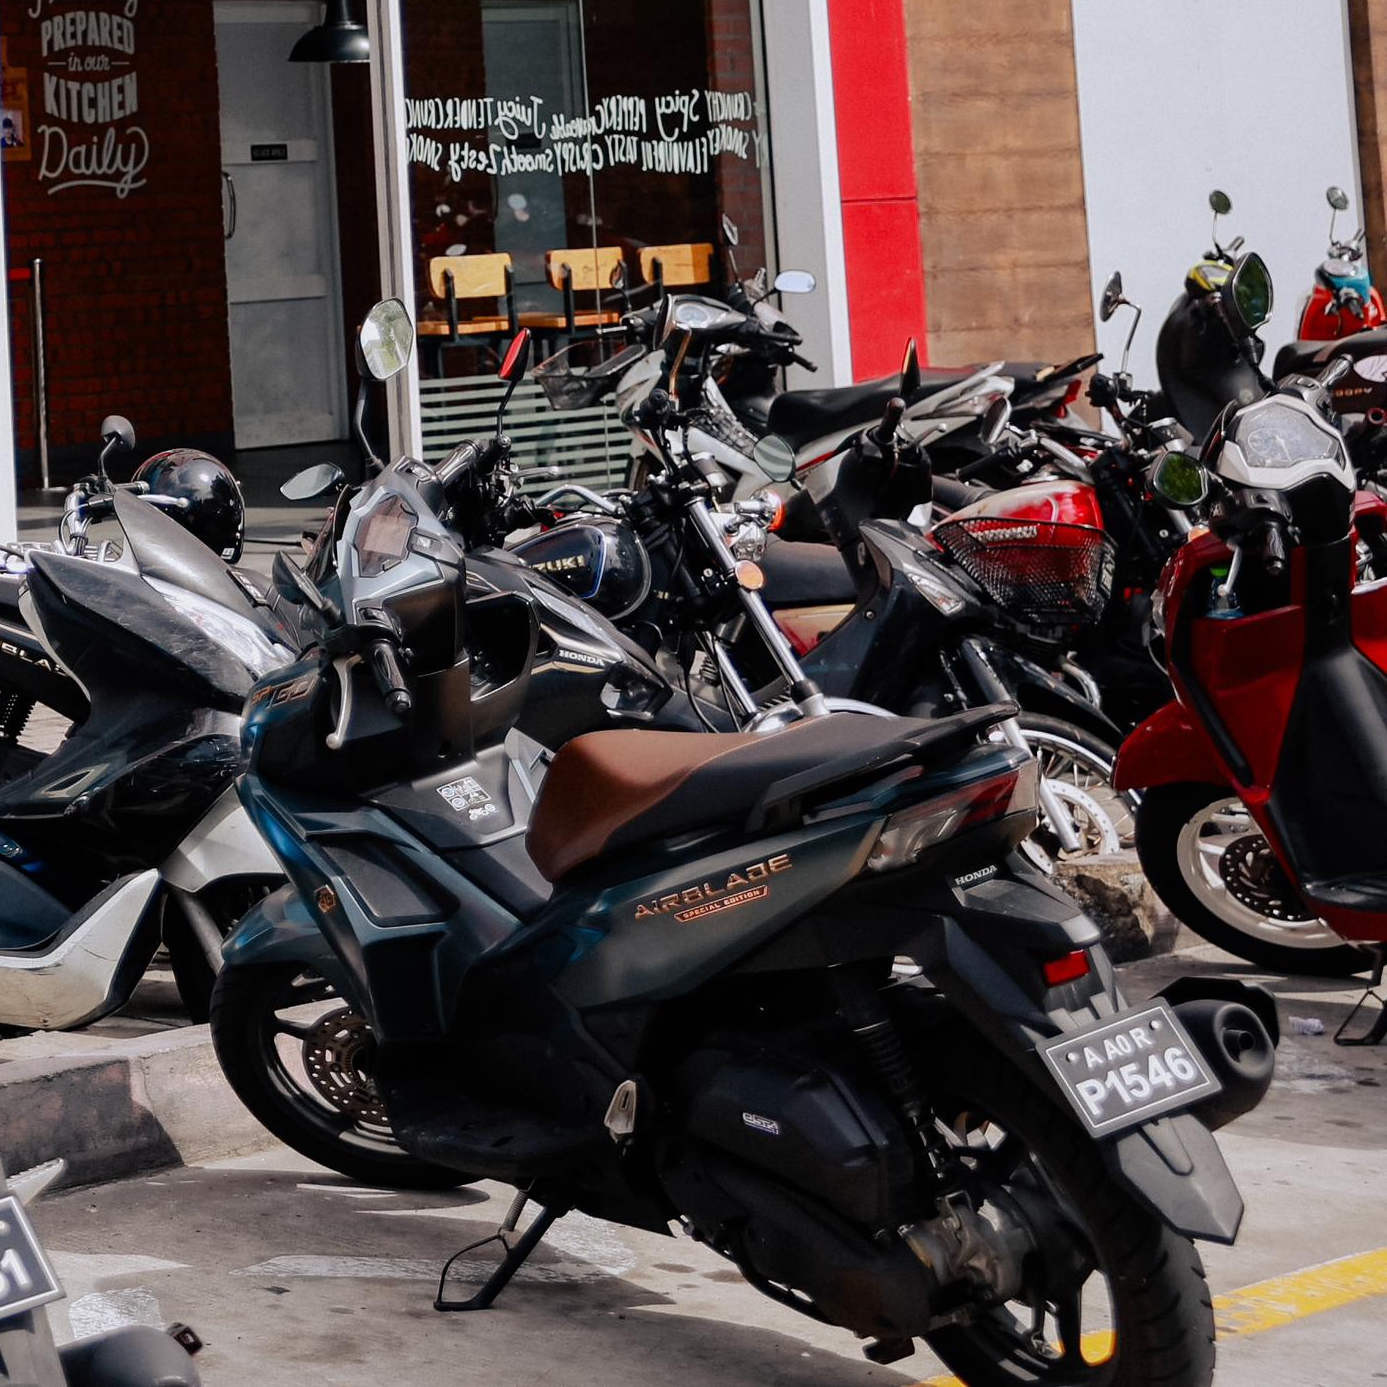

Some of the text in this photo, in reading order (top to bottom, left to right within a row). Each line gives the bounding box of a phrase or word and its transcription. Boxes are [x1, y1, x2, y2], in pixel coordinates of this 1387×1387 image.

[41, 11, 135, 57] PREPARED
[67, 53, 111, 71] in our
[43, 71, 138, 124] KITCHEN
[37, 124, 149, 199] Daily
[558, 649, 606, 667] HONDA
[634, 853, 793, 920] AIRBLADE
[954, 864, 998, 886] HONDA
[682, 889, 761, 919] SPECIAL EDITION
[1075, 1047, 1196, 1116] P1546
